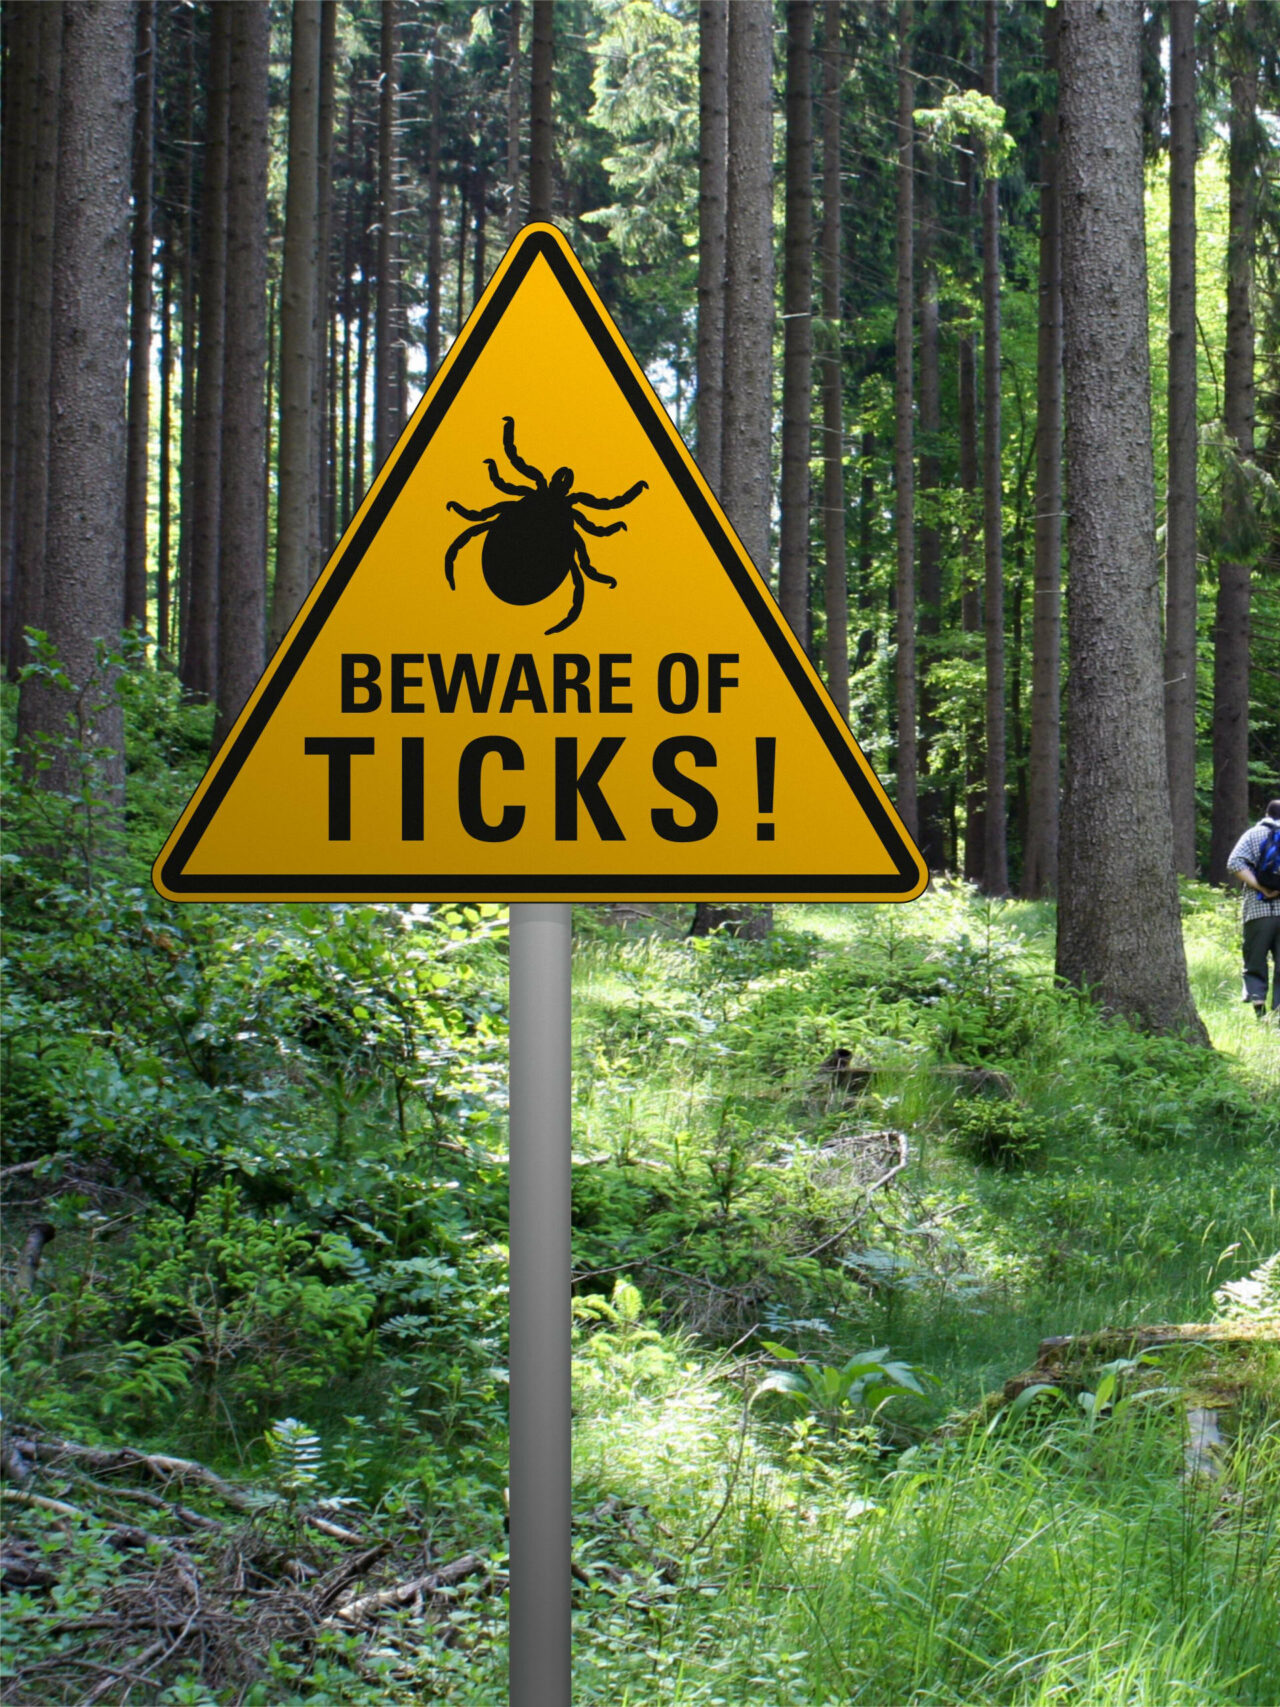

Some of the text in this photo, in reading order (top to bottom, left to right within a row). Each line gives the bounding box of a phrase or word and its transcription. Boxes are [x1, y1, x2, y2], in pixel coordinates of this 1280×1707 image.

[341, 652, 740, 714] BEWARE OF
[304, 735, 777, 843] TICKS!
